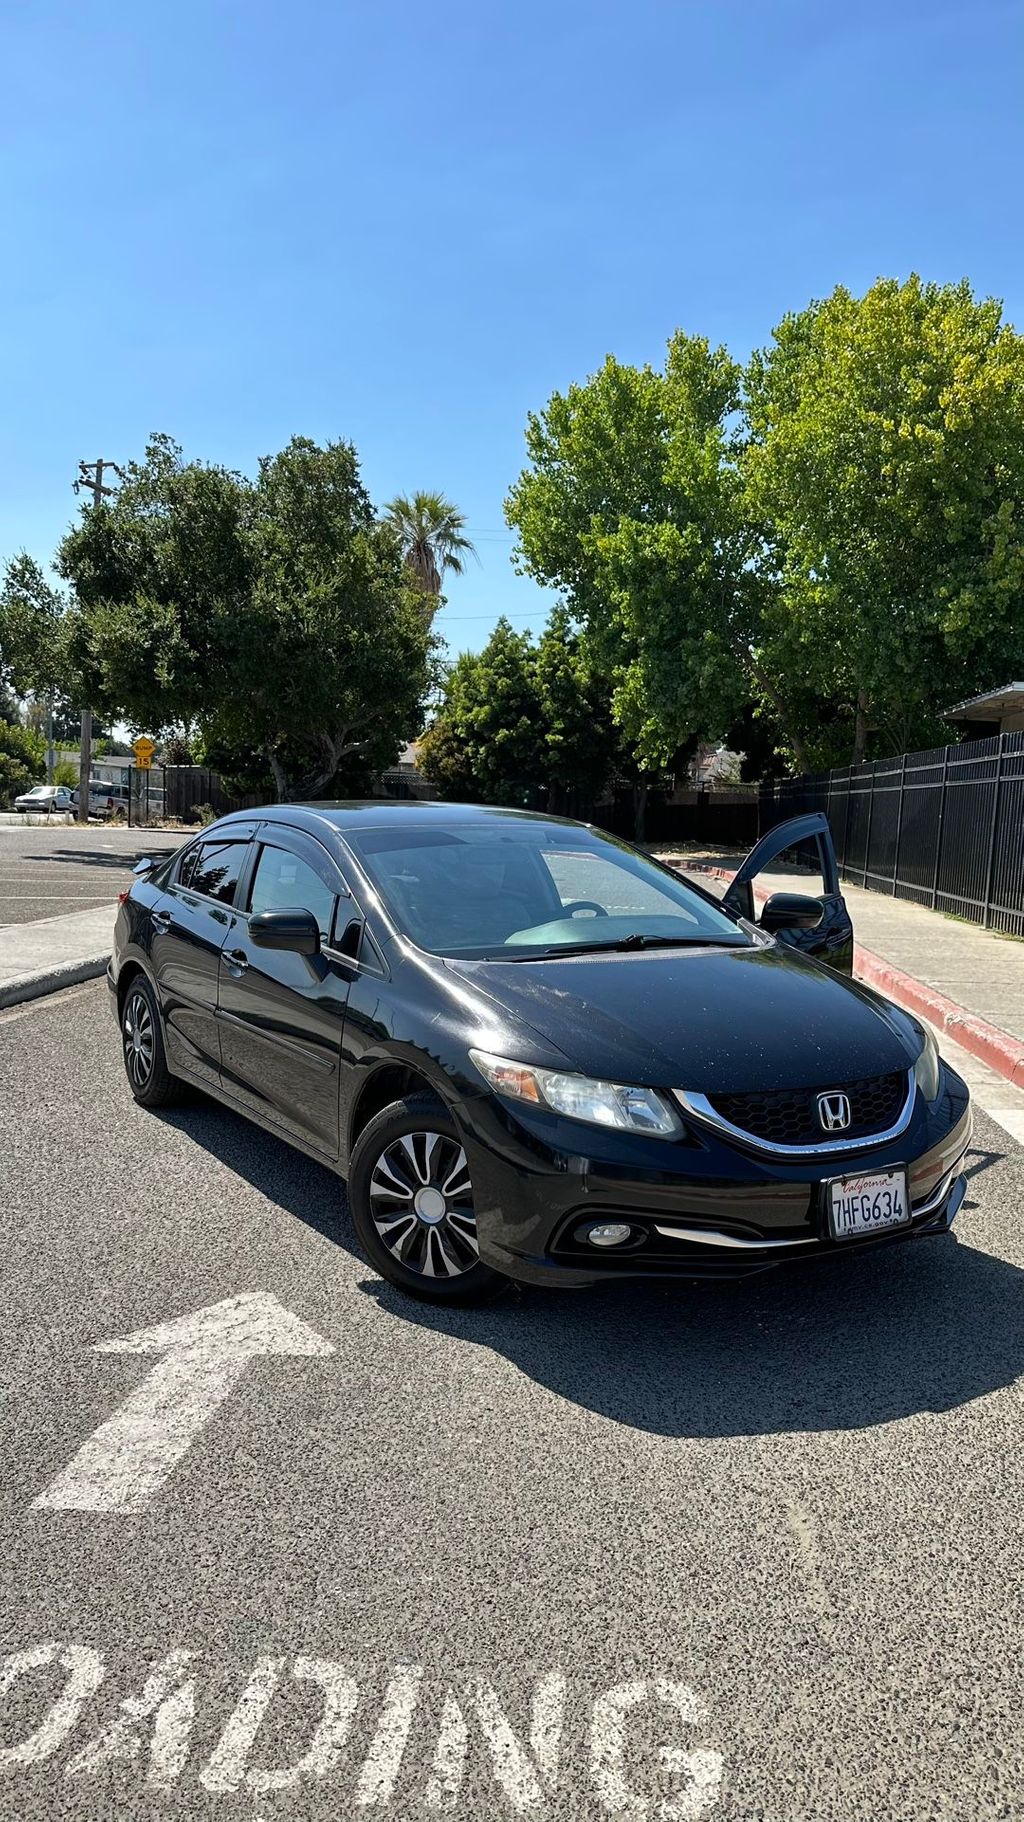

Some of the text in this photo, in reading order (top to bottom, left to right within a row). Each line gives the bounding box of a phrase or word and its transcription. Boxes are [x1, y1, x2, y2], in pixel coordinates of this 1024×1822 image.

[139, 757, 149, 765] 15
[842, 1178, 892, 1194] California
[833, 1189, 903, 1230] 7HFG634
